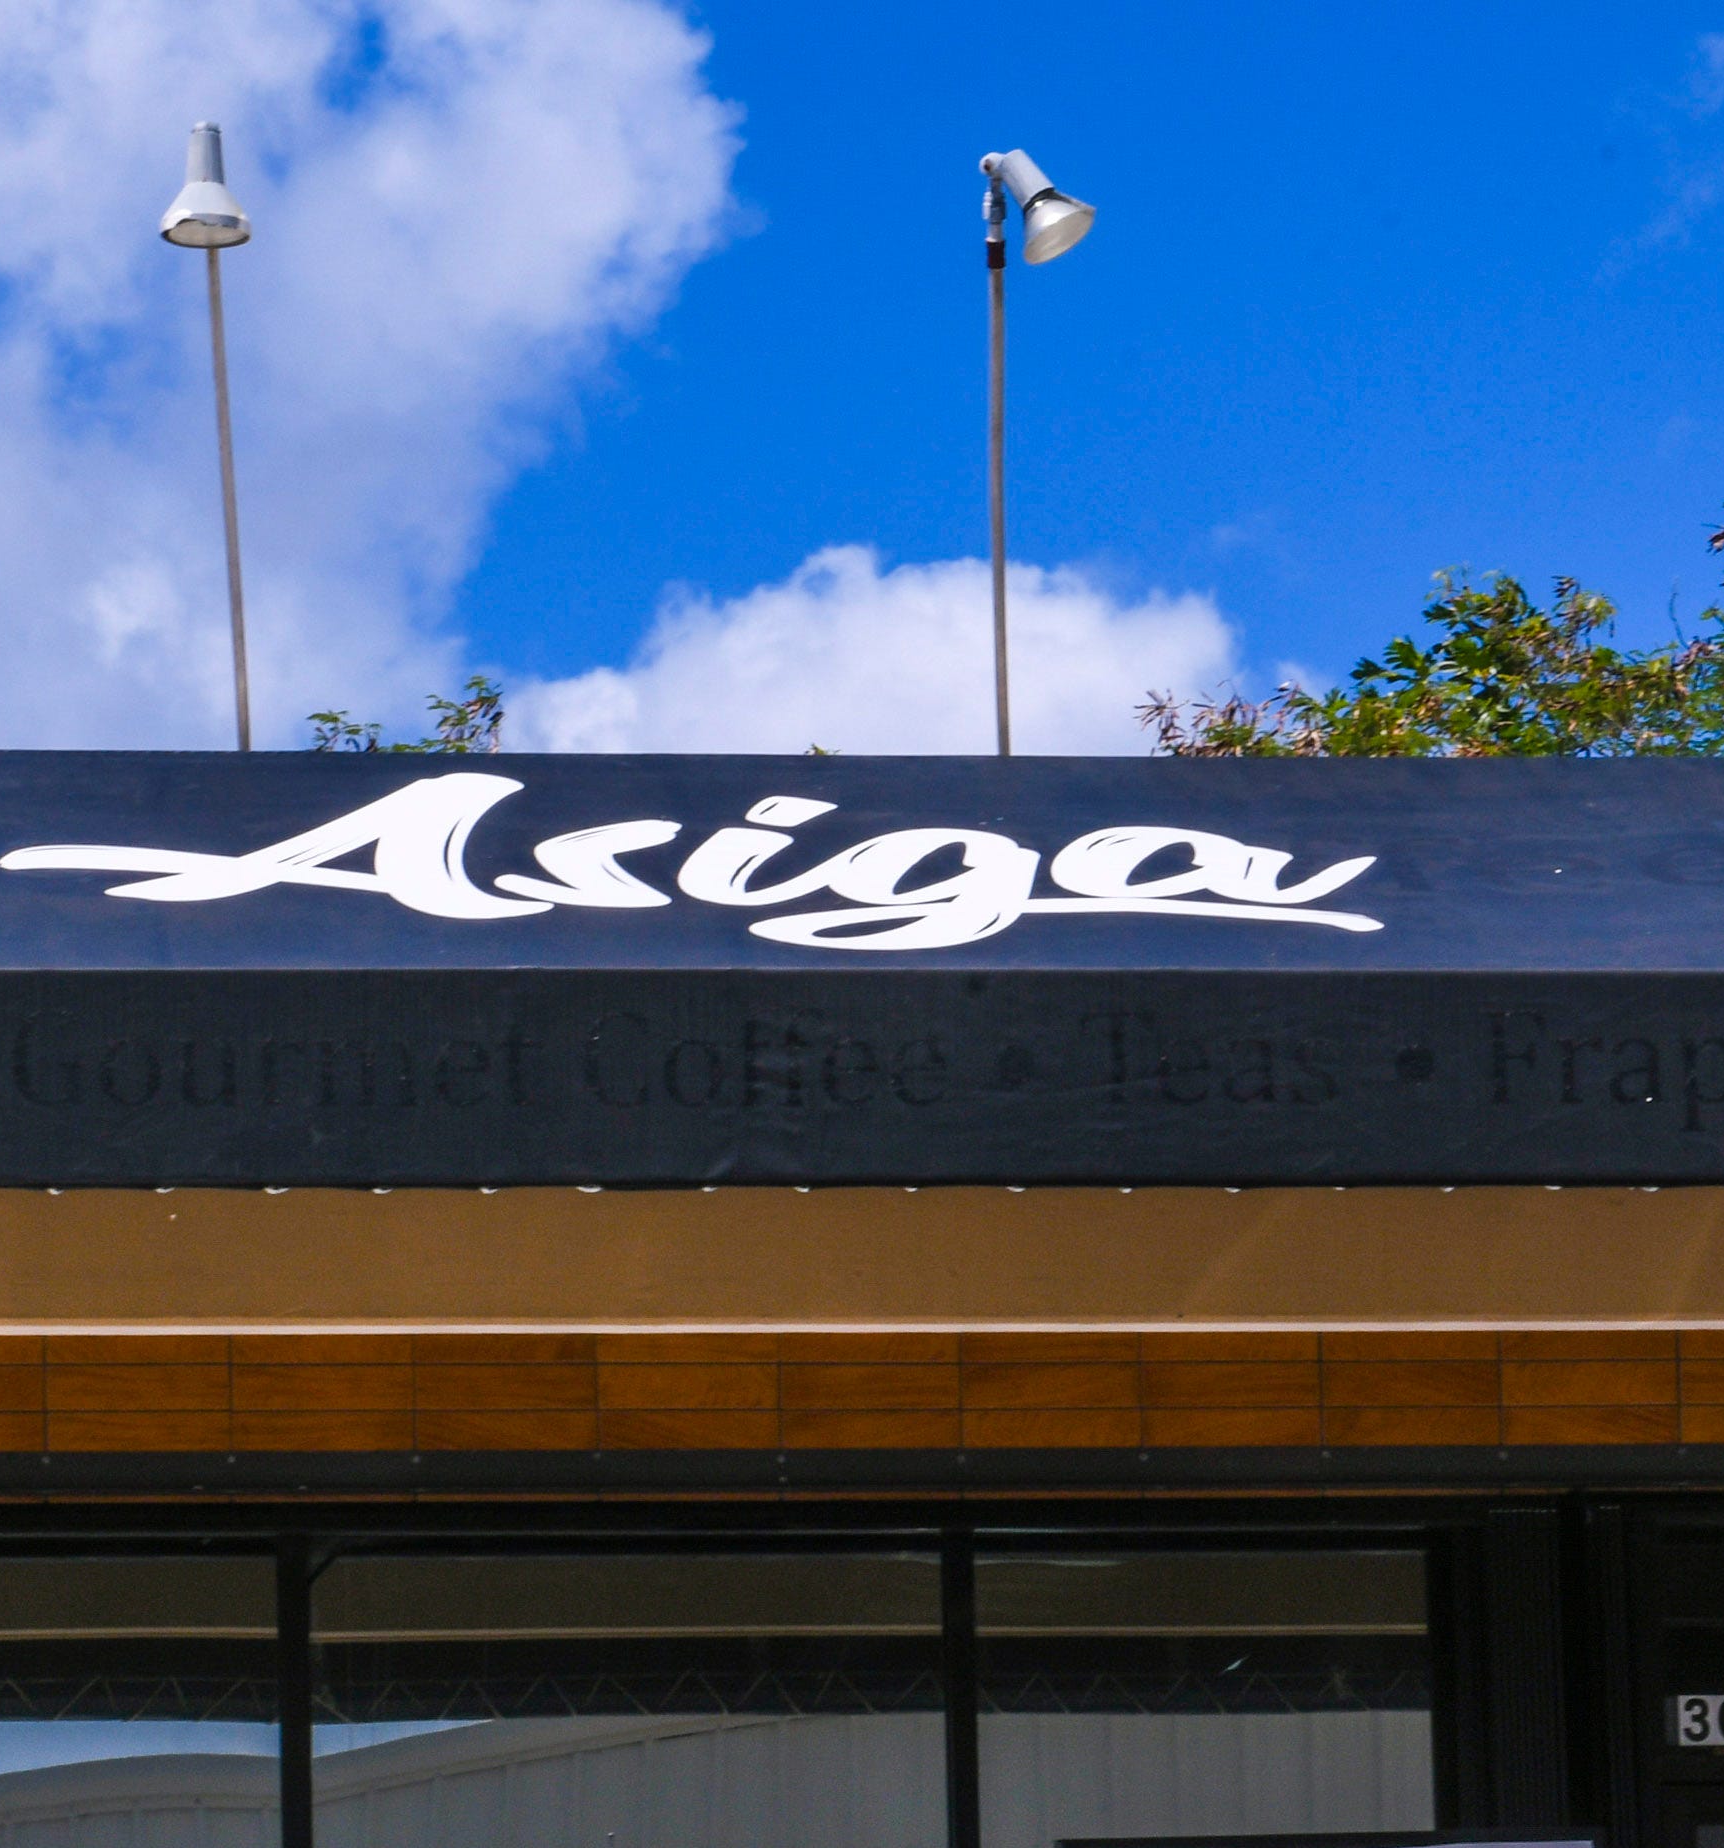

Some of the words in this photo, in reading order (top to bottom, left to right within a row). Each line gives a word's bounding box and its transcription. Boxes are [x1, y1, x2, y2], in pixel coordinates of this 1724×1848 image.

[11, 1008, 543, 1111] Gourmet
[583, 1006, 951, 1111] Coffee
[1078, 1009, 1339, 1110] Teas
